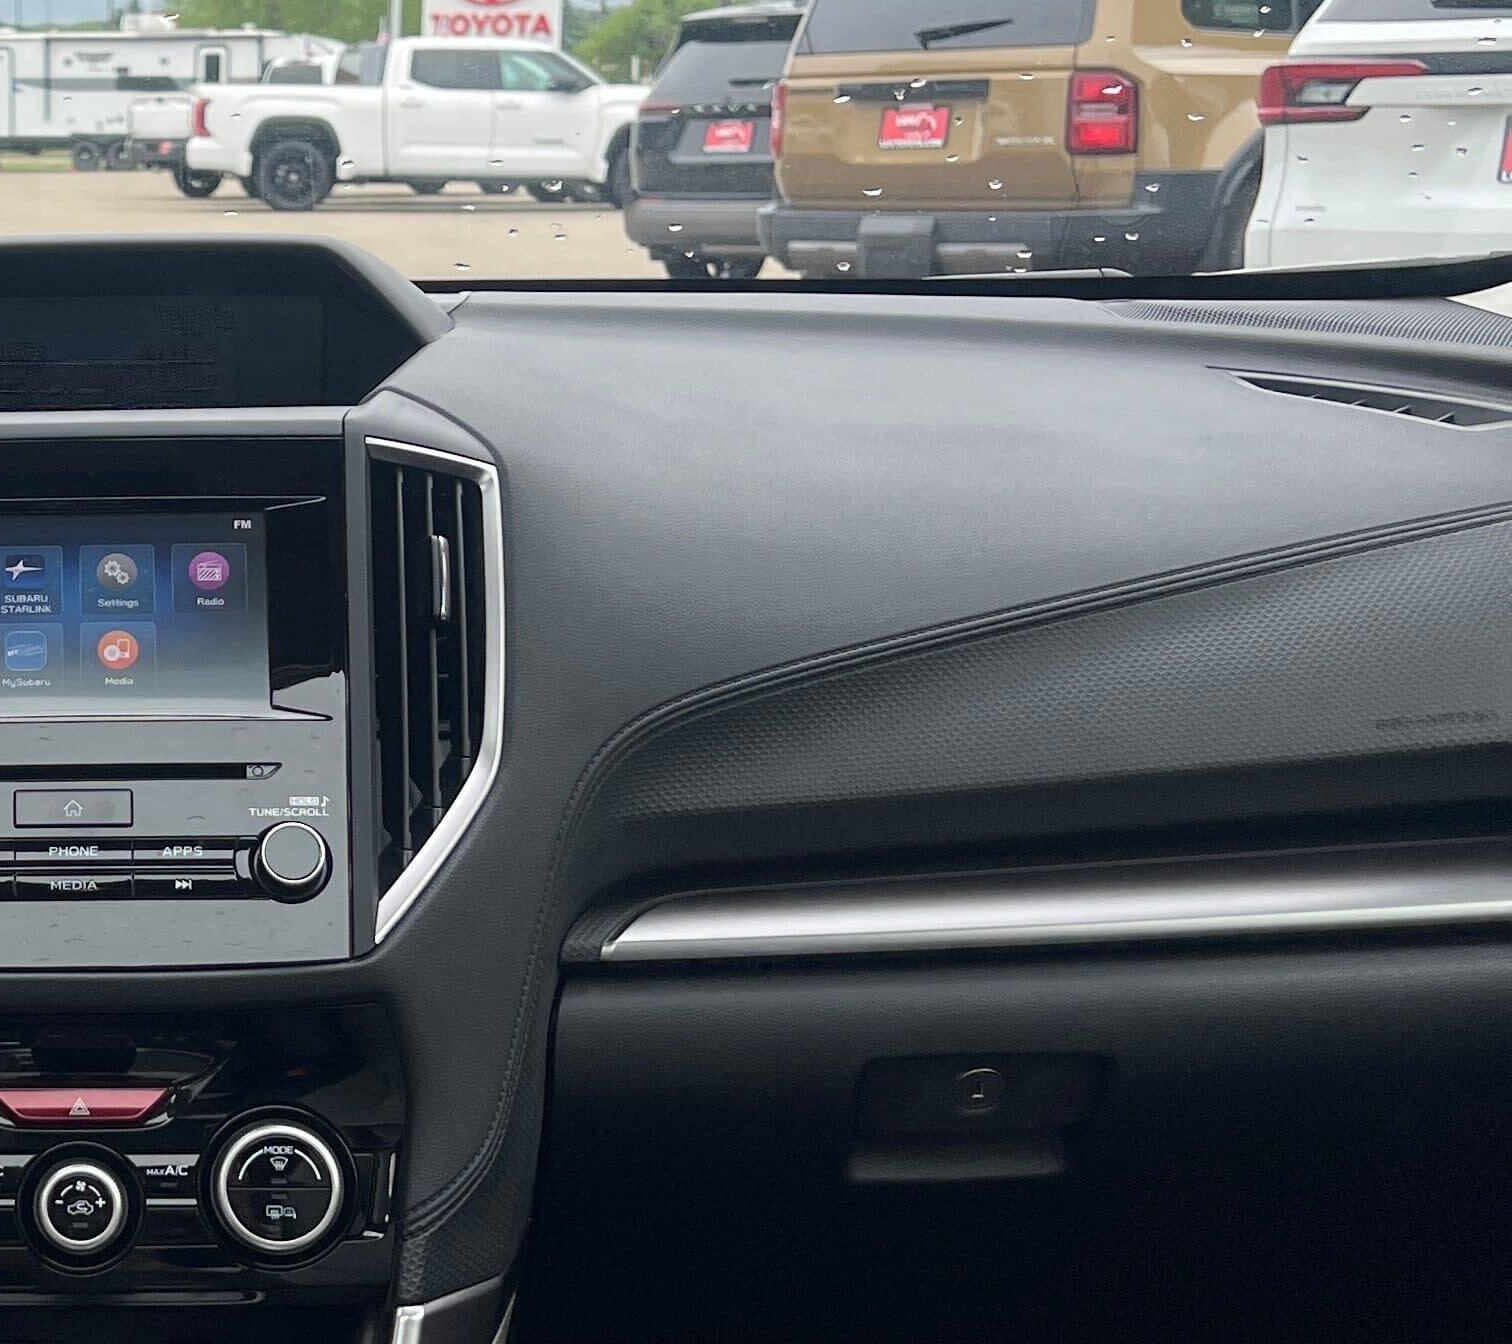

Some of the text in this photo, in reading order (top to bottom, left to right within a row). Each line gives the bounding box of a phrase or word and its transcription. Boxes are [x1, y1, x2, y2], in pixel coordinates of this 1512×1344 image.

[432, 13, 552, 35] TOYOTA
[233, 519, 252, 530] FM
[4, 594, 49, 603] SUBARU
[97, 598, 139, 609] Settings
[196, 597, 225, 606] Radio
[0, 605, 52, 614] STARLINK
[1, 678, 51, 688] MySubaru
[104, 676, 134, 685] Media
[248, 807, 330, 817] TUNE/SCROLL
[48, 845, 99, 857] PHONE
[162, 845, 204, 857] APPS
[50, 880, 97, 891] MEDIA
[263, 1146, 294, 1155] MODE
[165, 1165, 189, 1176] A/C
